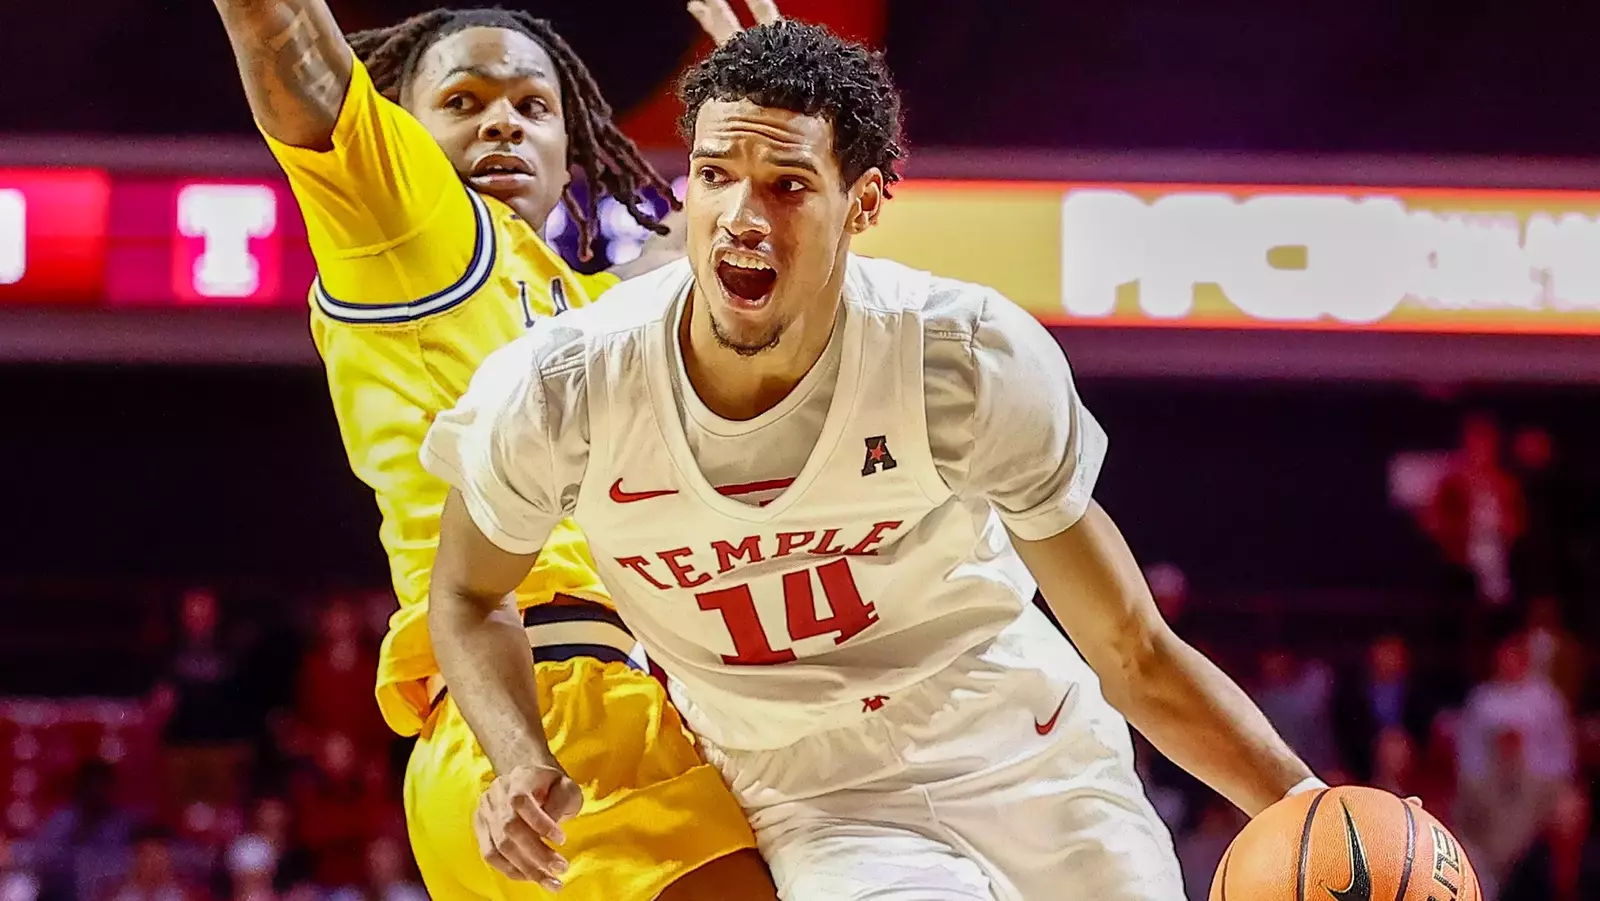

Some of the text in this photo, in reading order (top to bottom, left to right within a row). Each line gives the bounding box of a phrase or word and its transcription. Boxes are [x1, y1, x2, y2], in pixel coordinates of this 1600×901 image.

[177, 184, 276, 298] T
[861, 435, 897, 477] A
[614, 520, 904, 590] TEMPLE
[694, 556, 880, 666] 14
